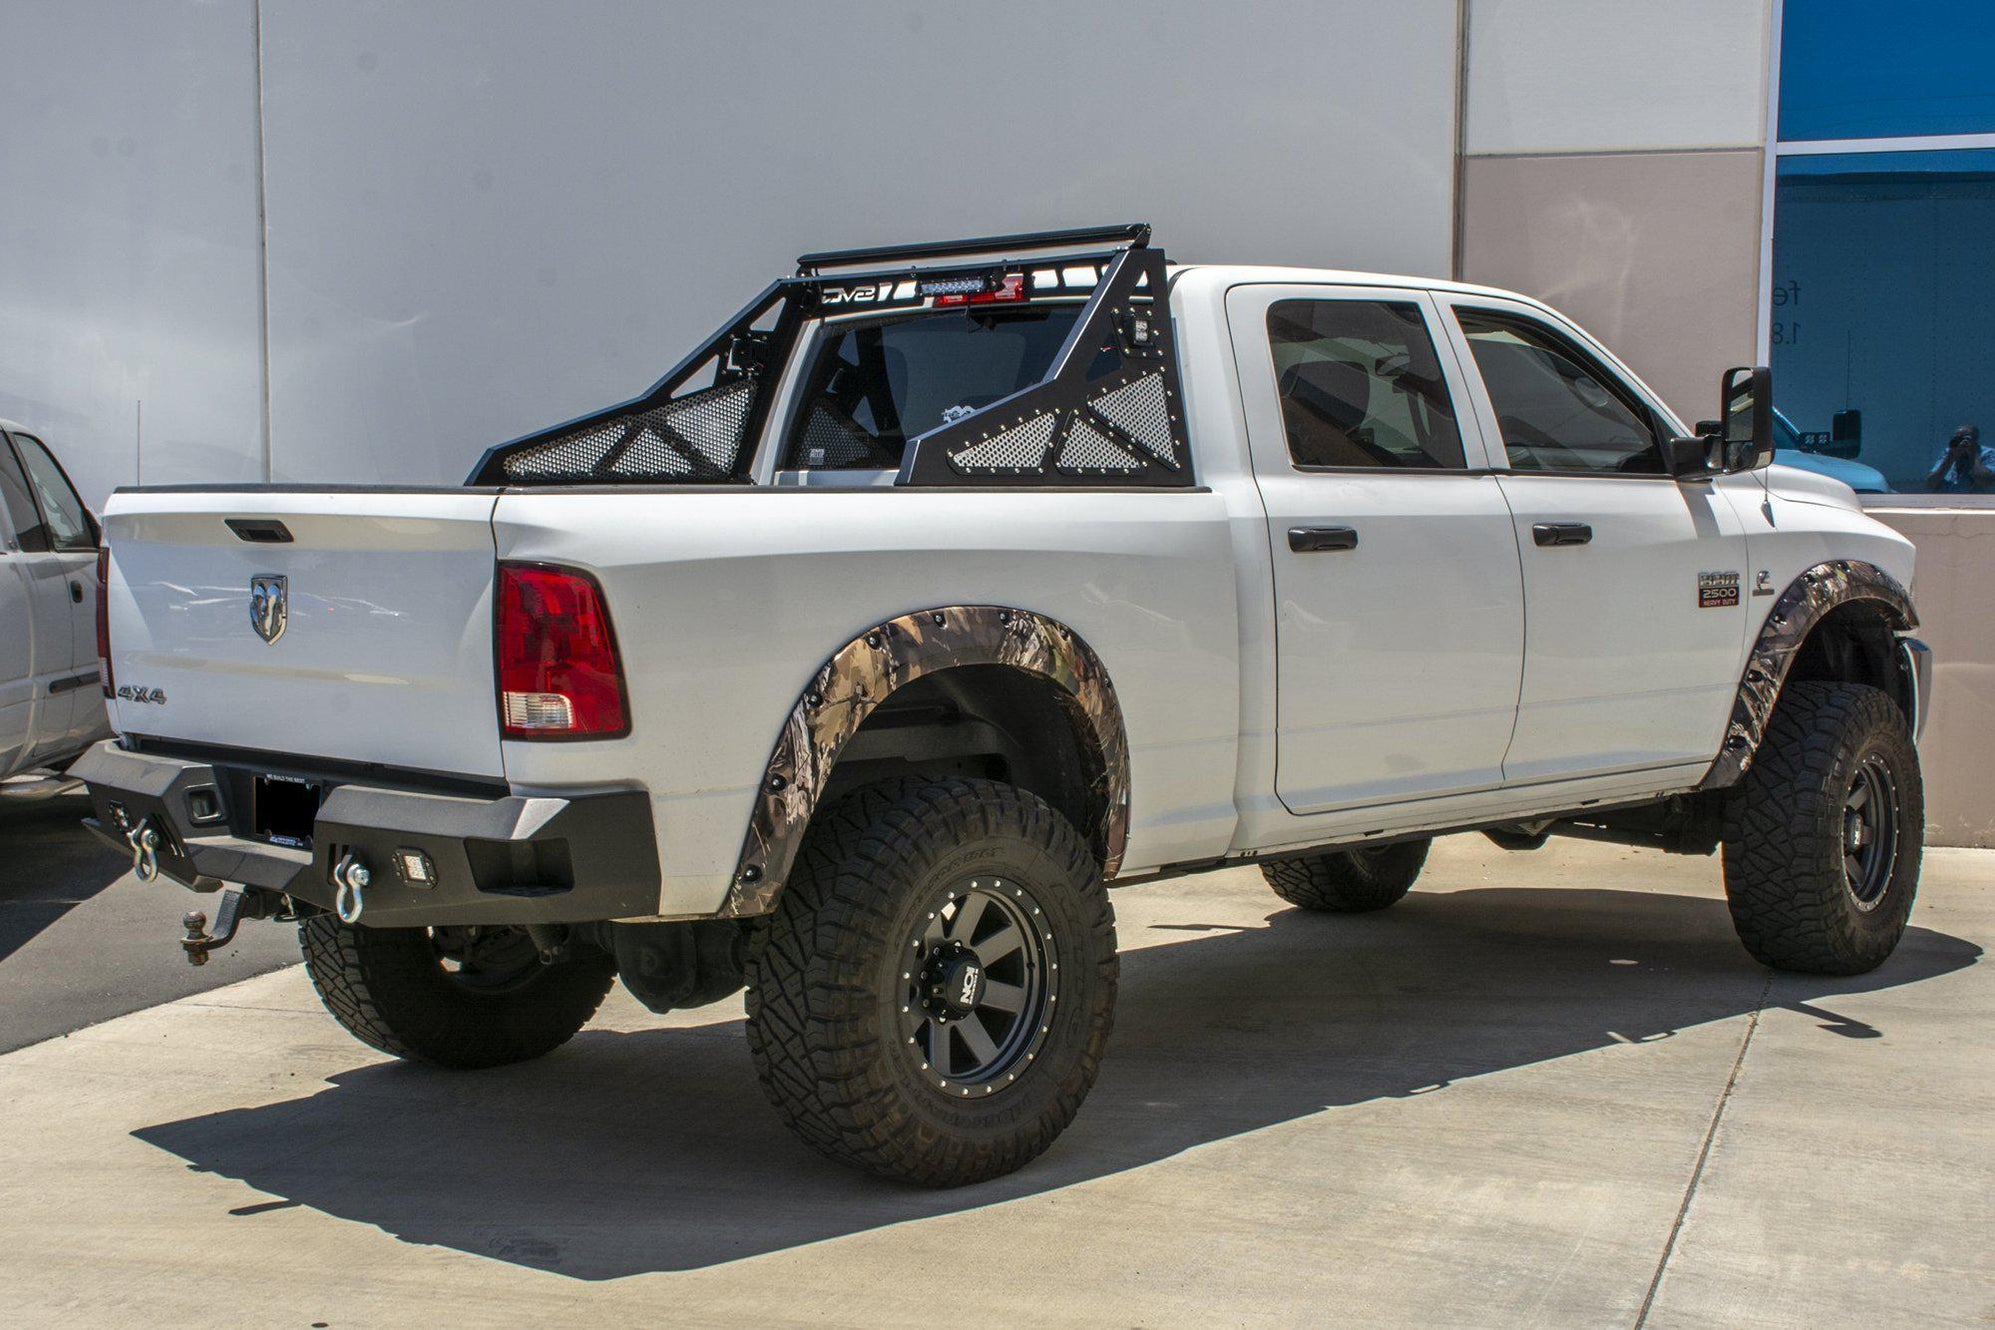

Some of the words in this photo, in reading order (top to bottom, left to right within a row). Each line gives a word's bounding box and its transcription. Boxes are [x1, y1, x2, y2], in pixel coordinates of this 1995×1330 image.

[1698, 572, 1739, 587] RAM
[1702, 588, 1737, 599] 2500
[117, 686, 168, 705] 4X4
